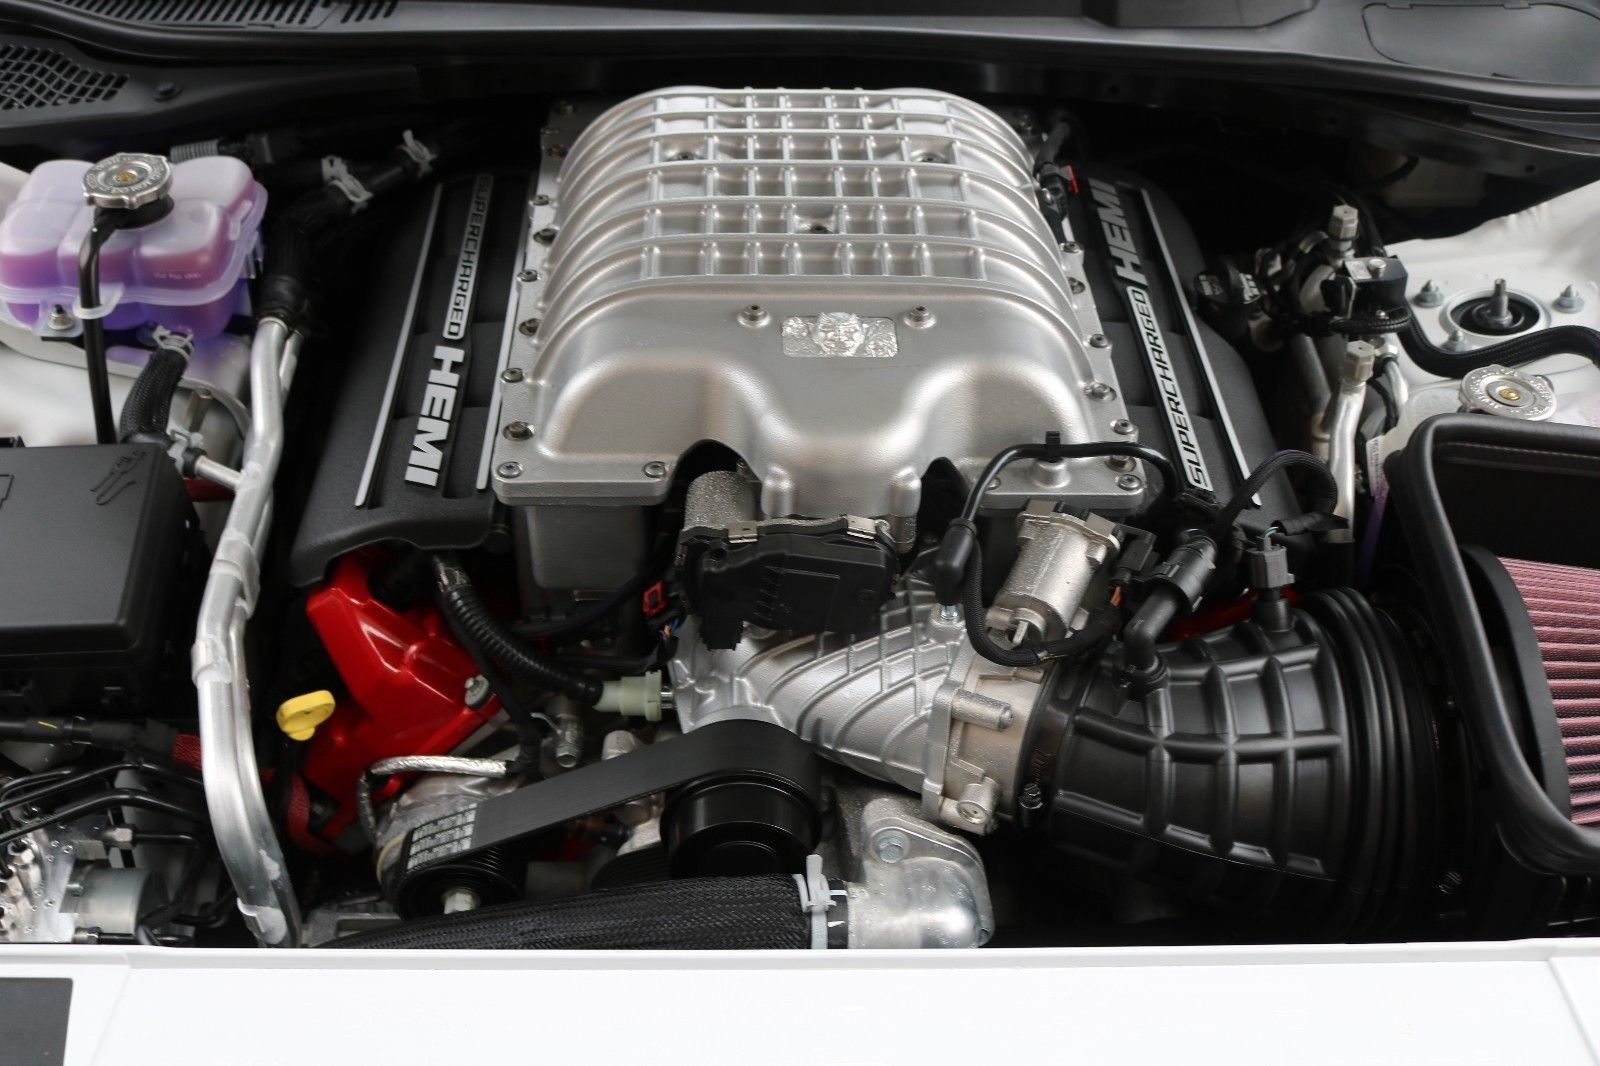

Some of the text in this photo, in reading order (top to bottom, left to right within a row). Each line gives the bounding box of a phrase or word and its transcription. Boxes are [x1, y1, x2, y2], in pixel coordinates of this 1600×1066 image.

[404, 175, 493, 487] SUPERCHARGED HEMI
[1088, 177, 1212, 489] SUPERCHARGED HEMI
